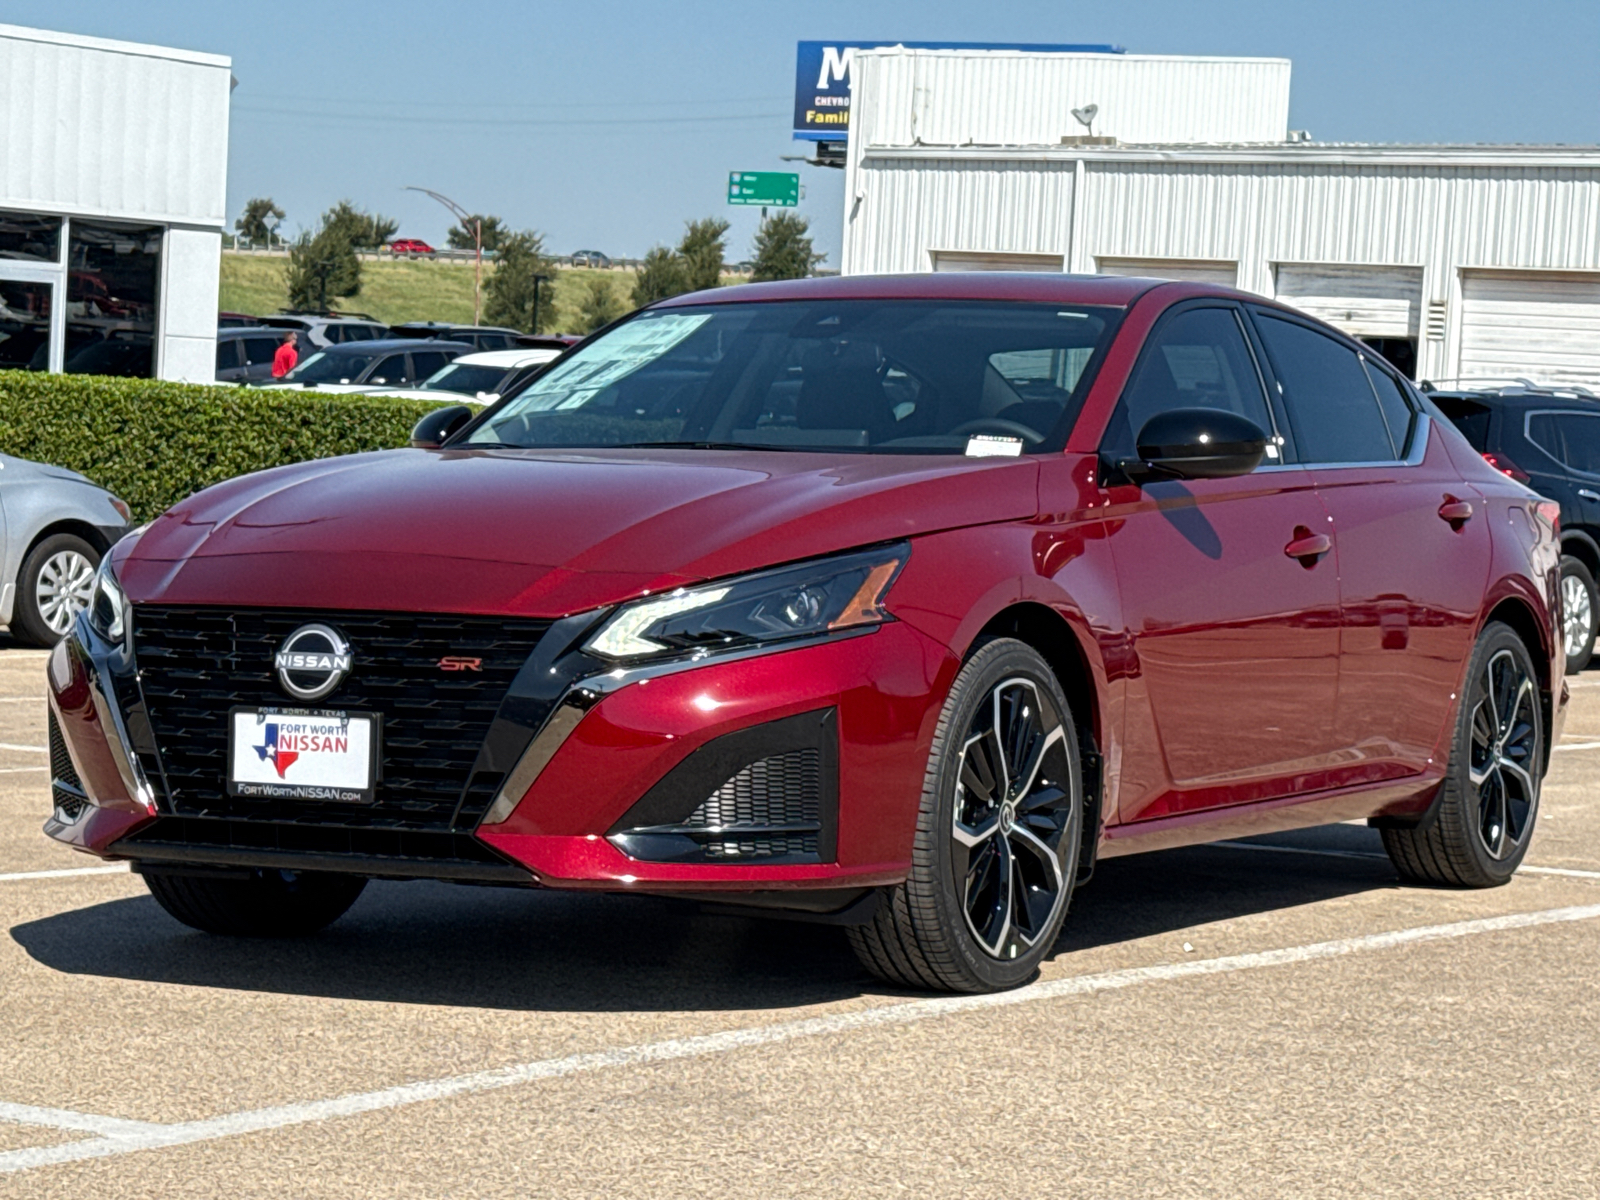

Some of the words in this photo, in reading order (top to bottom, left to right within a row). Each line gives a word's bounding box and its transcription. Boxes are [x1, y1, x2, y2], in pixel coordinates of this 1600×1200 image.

[275, 654, 349, 669] NISSAN
[440, 656, 482, 671] SR
[258, 706, 279, 714] FORT
[281, 708, 309, 716] WORTH
[320, 709, 347, 717] TEXAS
[280, 723, 308, 734] FORT
[309, 725, 348, 737] WORTH
[279, 734, 348, 754] NISSAN
